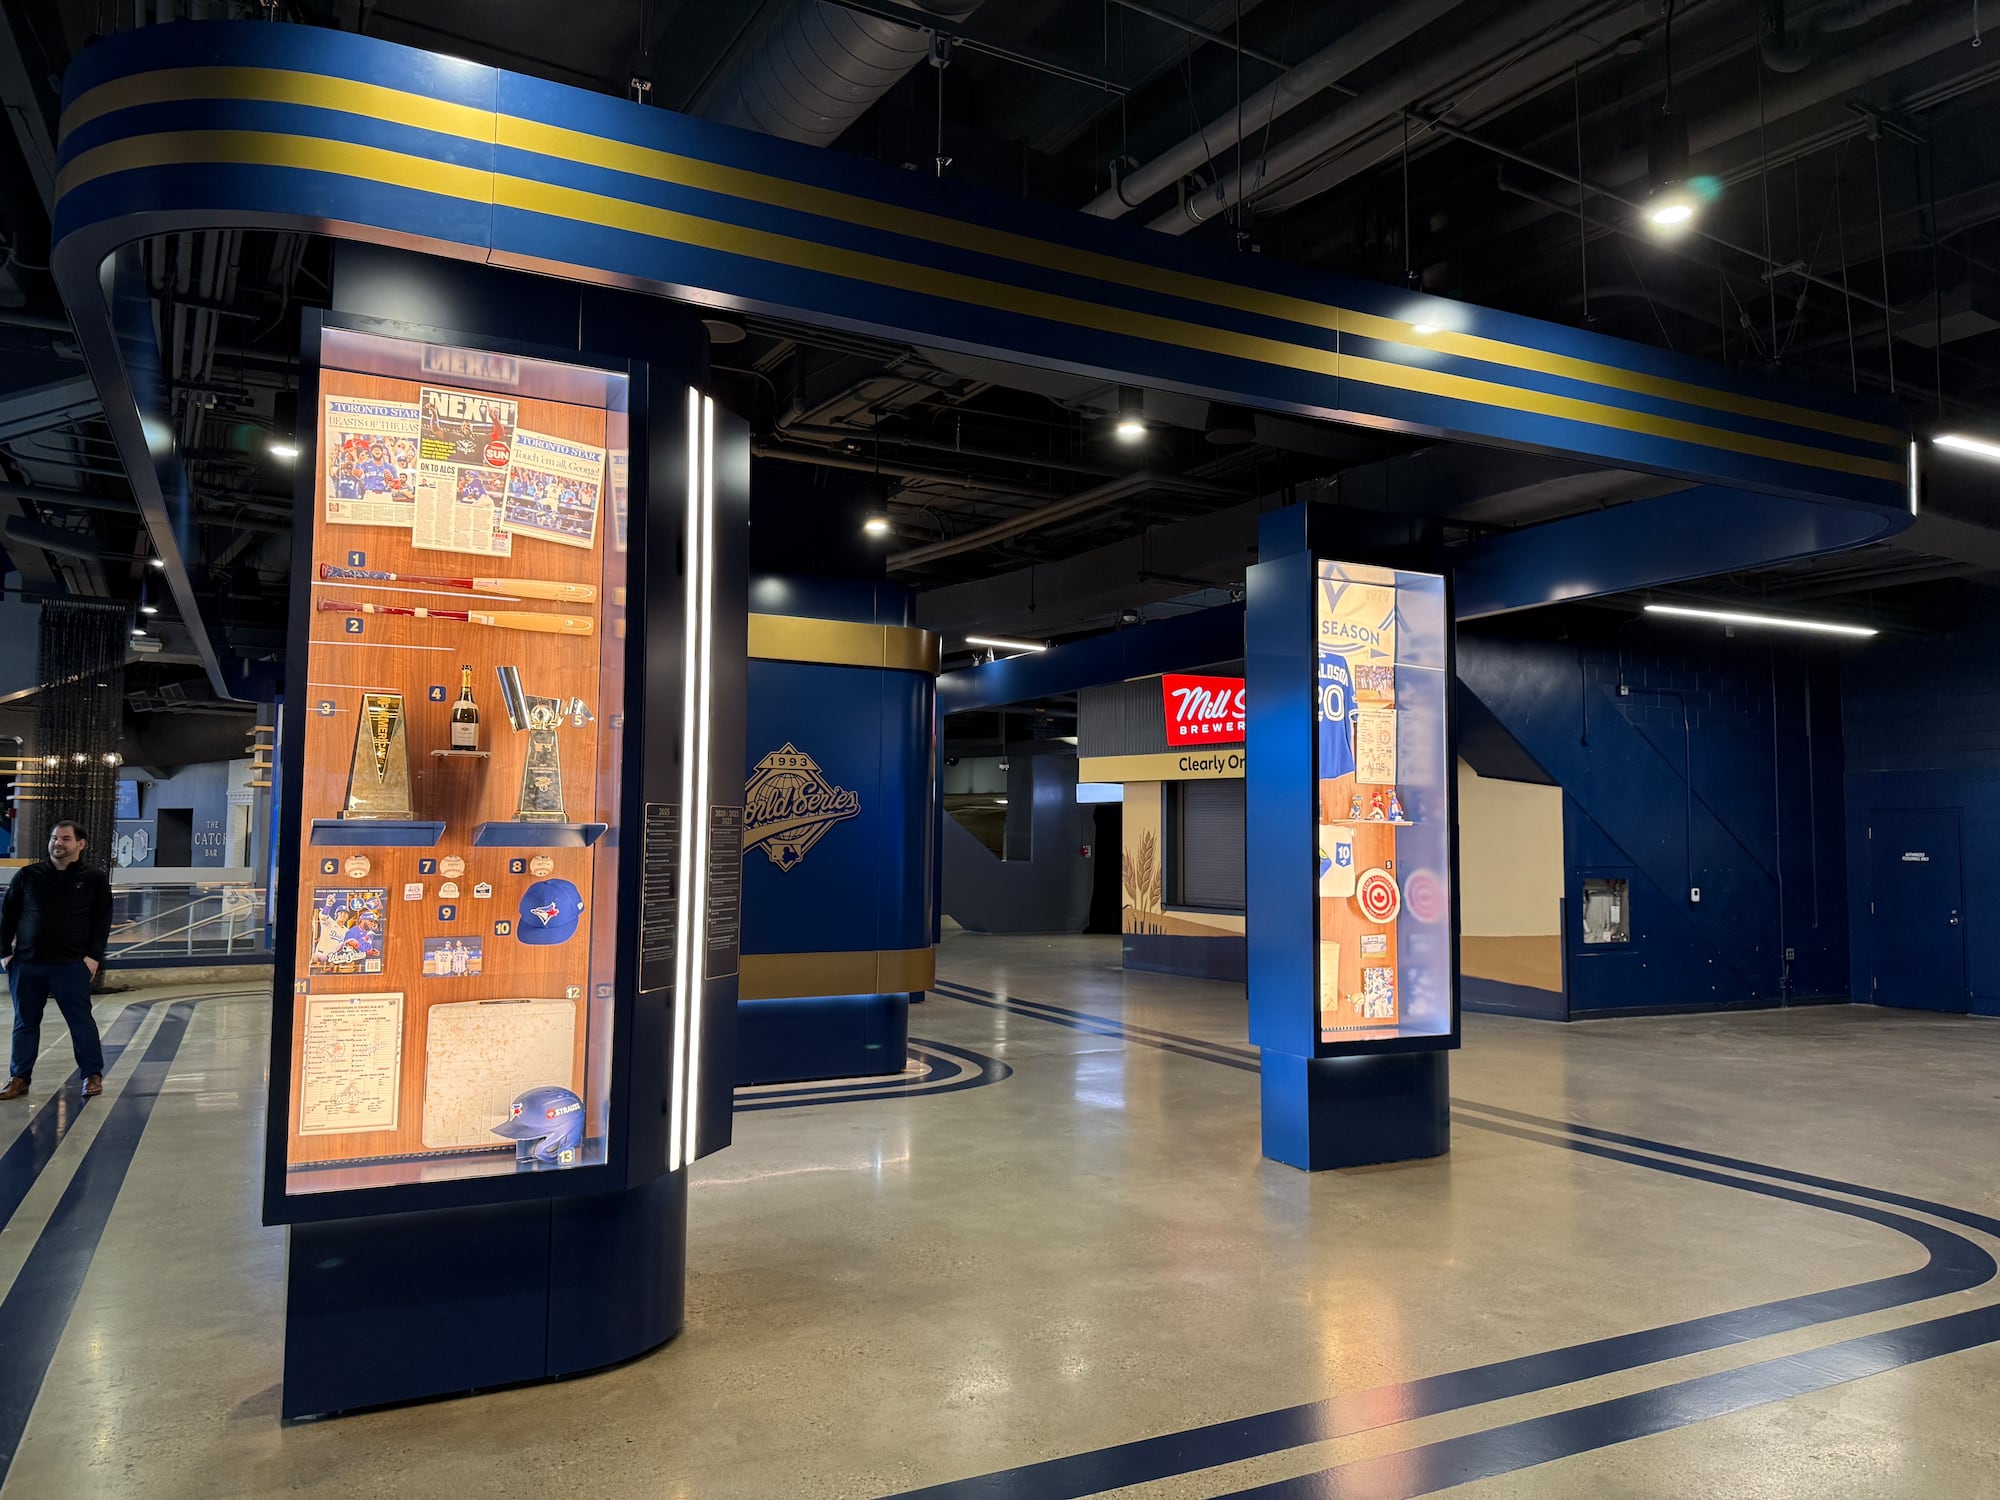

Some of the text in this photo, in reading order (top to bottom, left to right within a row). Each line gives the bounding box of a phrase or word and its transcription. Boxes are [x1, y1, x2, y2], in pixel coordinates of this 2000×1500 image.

[335, 403, 418, 418] TORONTO STAR
[329, 416, 362, 427] BEASTS
[365, 420, 377, 428] OF
[379, 421, 400, 431] THE
[487, 449, 509, 460] SUN
[522, 436, 596, 461] TORONTO STAR
[421, 463, 455, 474] ON TO ALCS
[352, 553, 361, 565] 1
[349, 620, 360, 632] 2
[1322, 620, 1380, 647] SEASON
[432, 688, 441, 699] 4
[321, 703, 331, 714] 3
[1171, 686, 1232, 722] Mill
[573, 715, 583, 726] 5
[769, 756, 808, 767] 1993
[1179, 755, 1225, 773] Clearly
[792, 781, 858, 814] Series
[206, 820, 220, 829] THE
[204, 849, 218, 857] BAR
[1338, 846, 1350, 859] 10
[324, 861, 334, 873] 6
[422, 861, 432, 873] 7
[512, 861, 522, 872] 8
[1386, 861, 1392, 869] 5
[442, 908, 451, 919] 9
[496, 922, 510, 935] 10
[295, 981, 306, 993] 11
[566, 987, 580, 998] 12
[555, 1102, 581, 1117] STRAUSS
[560, 1149, 573, 1163] 13
